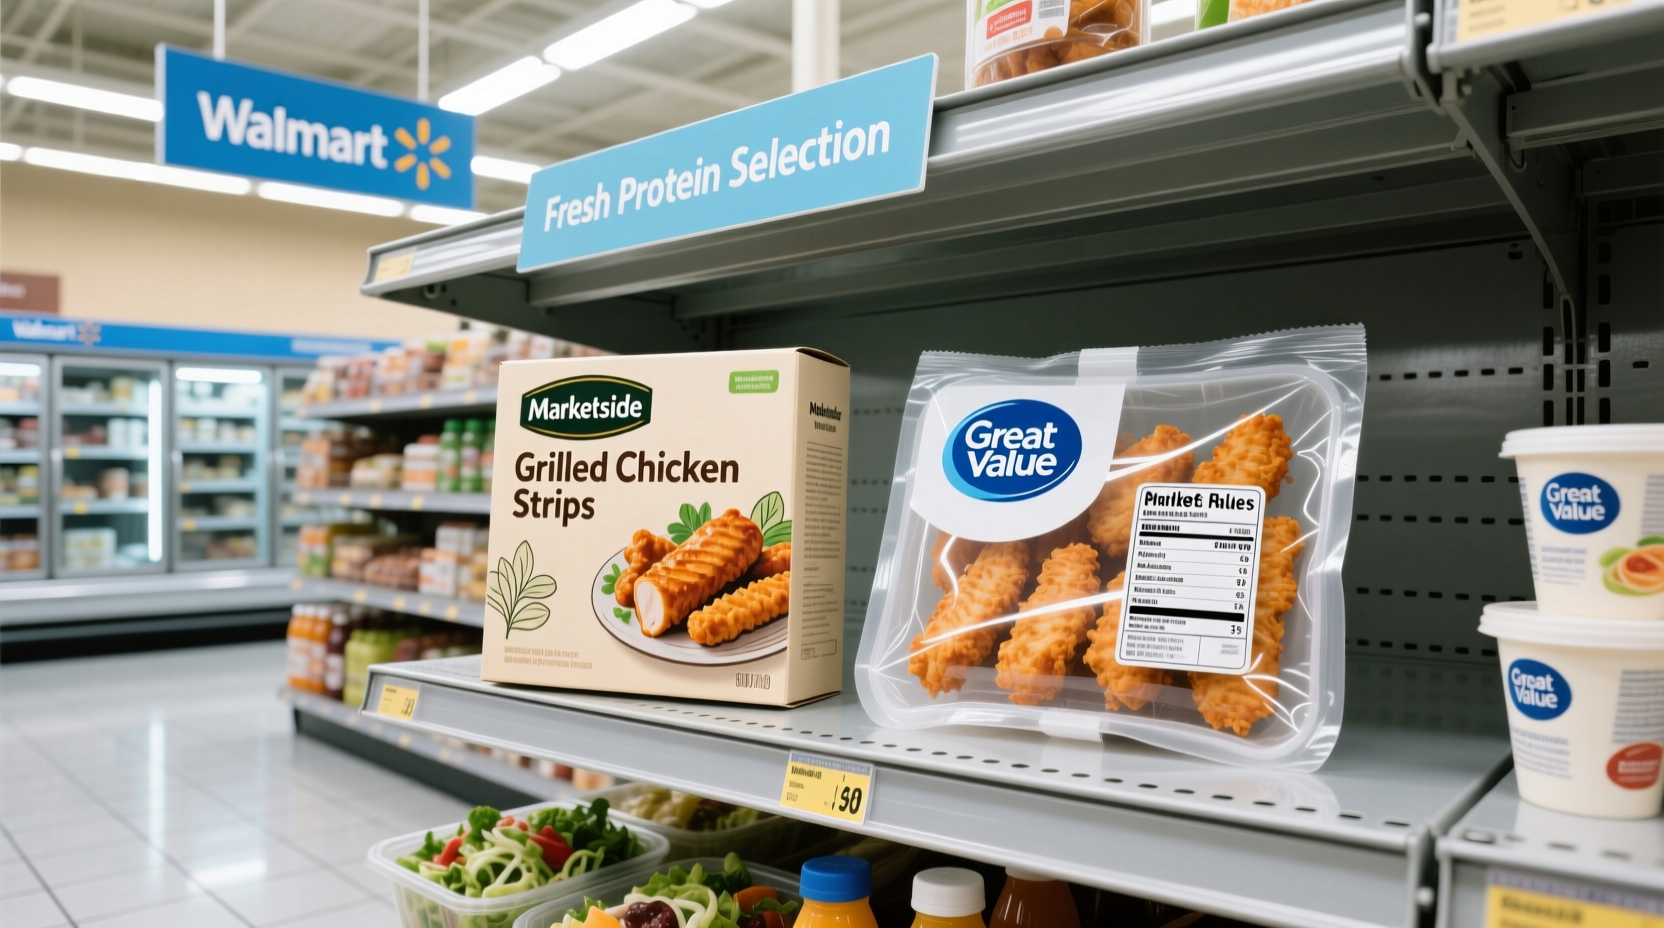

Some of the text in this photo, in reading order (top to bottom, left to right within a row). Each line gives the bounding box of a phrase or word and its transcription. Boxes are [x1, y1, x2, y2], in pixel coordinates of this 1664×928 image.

[196, 90, 389, 170] Walmart
[544, 119, 891, 232] Fresh Protein Selection
[528, 394, 642, 421] Marketside
[965, 419, 1058, 449] Great
[515, 450, 739, 483] Grilled Chicken
[967, 450, 1057, 478] Value
[1546, 482, 1602, 503] Great
[512, 488, 595, 527] Strips
[1549, 502, 1606, 520] Value
[1511, 667, 1554, 692] Great
[1514, 685, 1558, 708] Value
